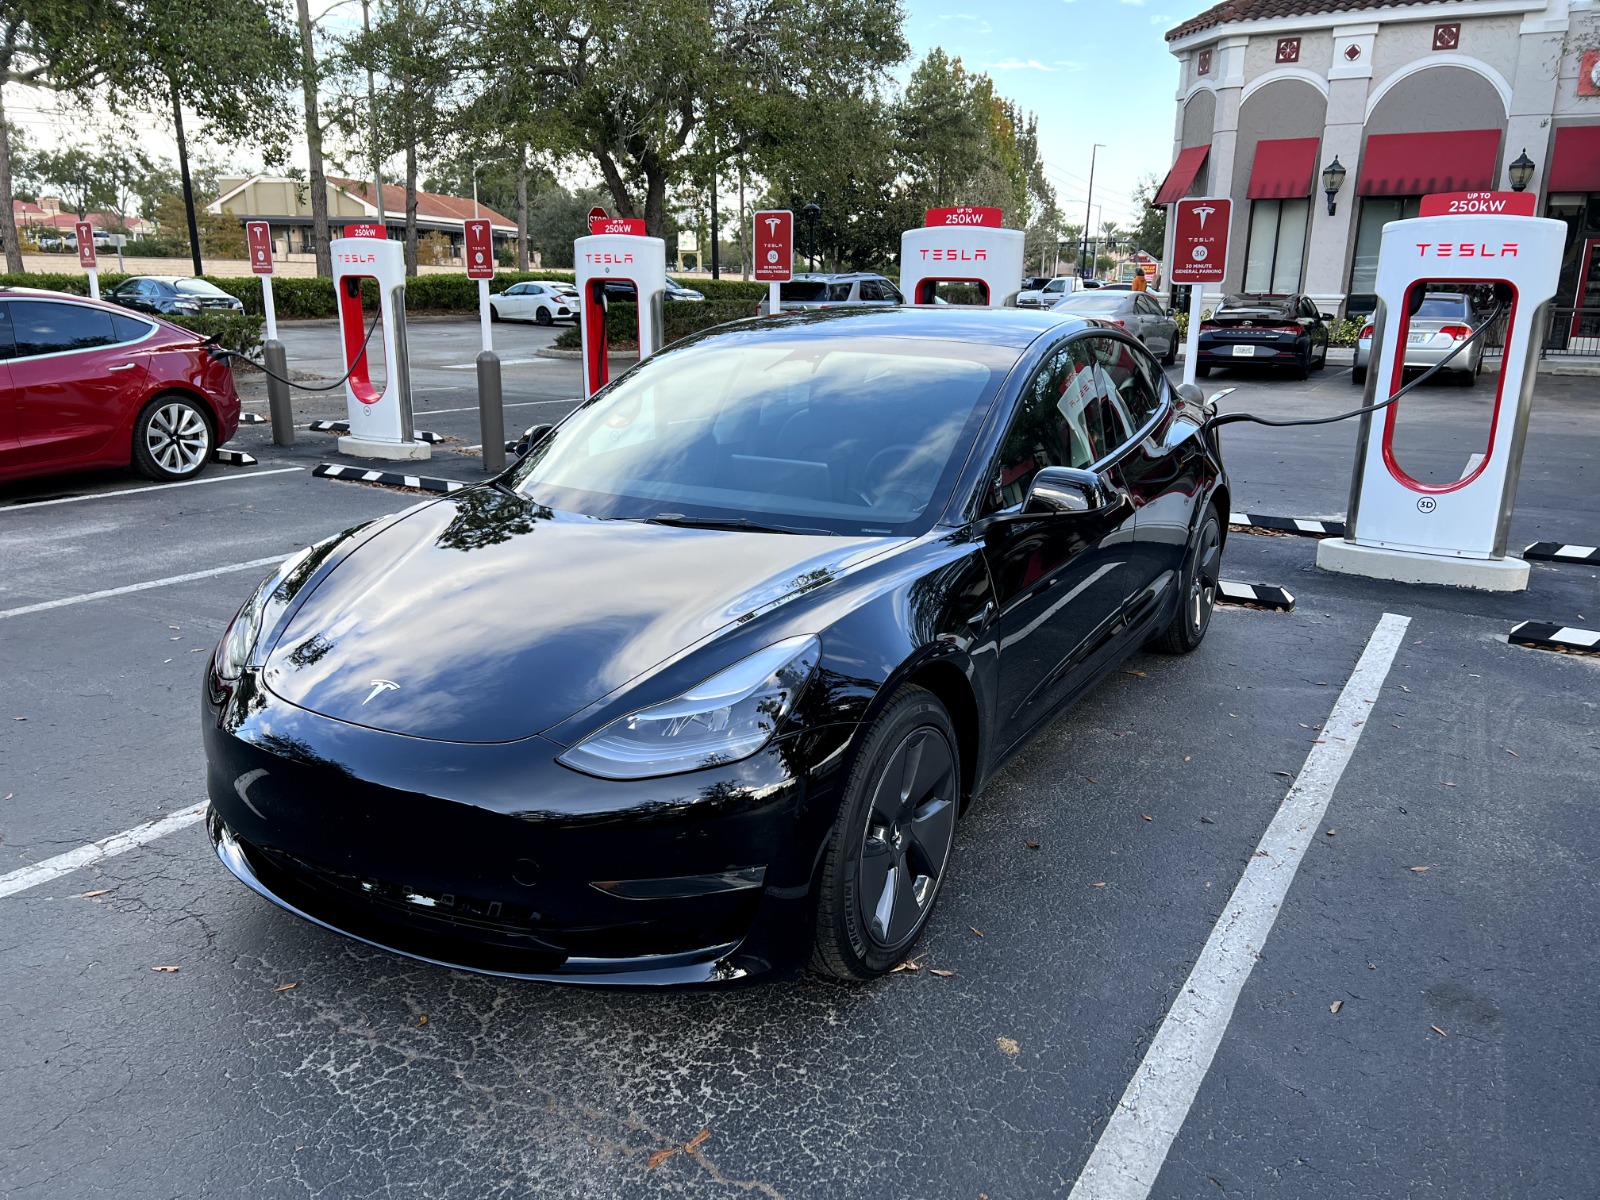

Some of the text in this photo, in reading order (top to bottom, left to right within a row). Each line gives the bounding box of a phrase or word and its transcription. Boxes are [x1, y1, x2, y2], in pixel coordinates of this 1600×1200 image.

[1449, 200, 1507, 212] 250kW
[946, 214, 983, 224] 250kW
[355, 229, 376, 237] 250kW
[605, 225, 632, 233] 250kW
[920, 249, 987, 261] TESLA
[1416, 243, 1518, 257] TESLA
[338, 254, 375, 263] TESLA
[586, 253, 633, 264] TESLA
[1419, 500, 1434, 509] 3D
[845, 884, 862, 948] MICHELIN
